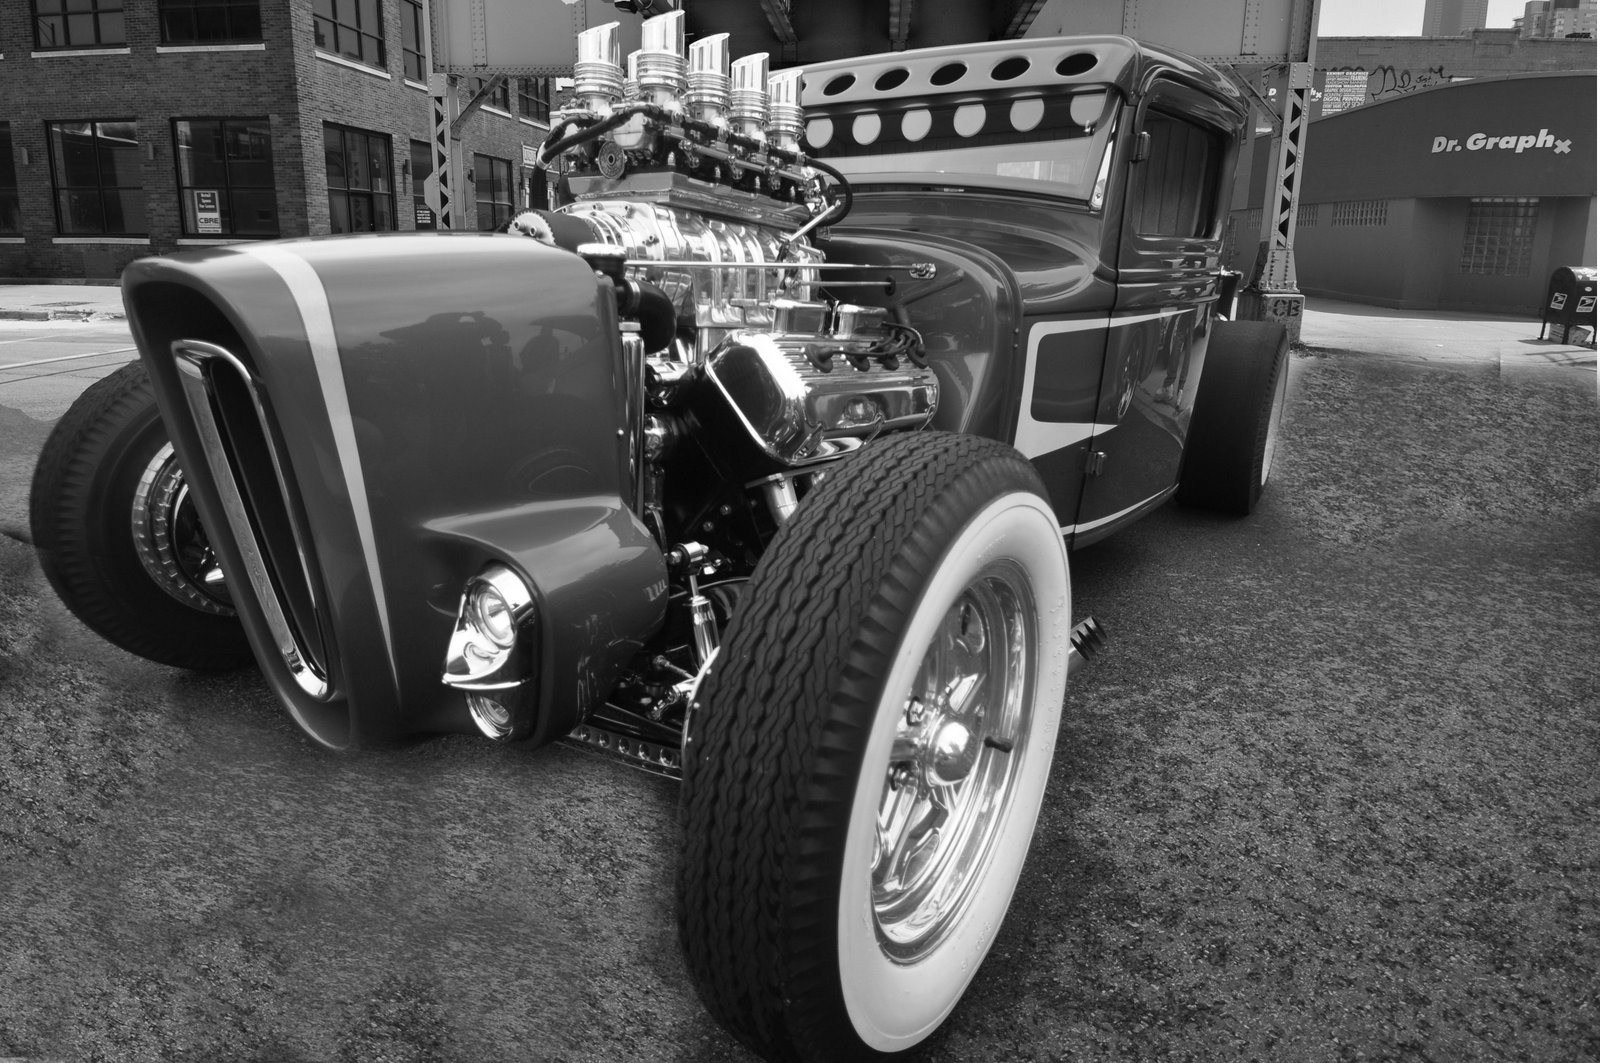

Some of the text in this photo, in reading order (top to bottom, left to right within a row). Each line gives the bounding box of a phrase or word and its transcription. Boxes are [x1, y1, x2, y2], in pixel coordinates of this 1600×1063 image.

[1431, 128, 1572, 154] Dr. Graphx
[1272, 299, 1301, 317] CB
